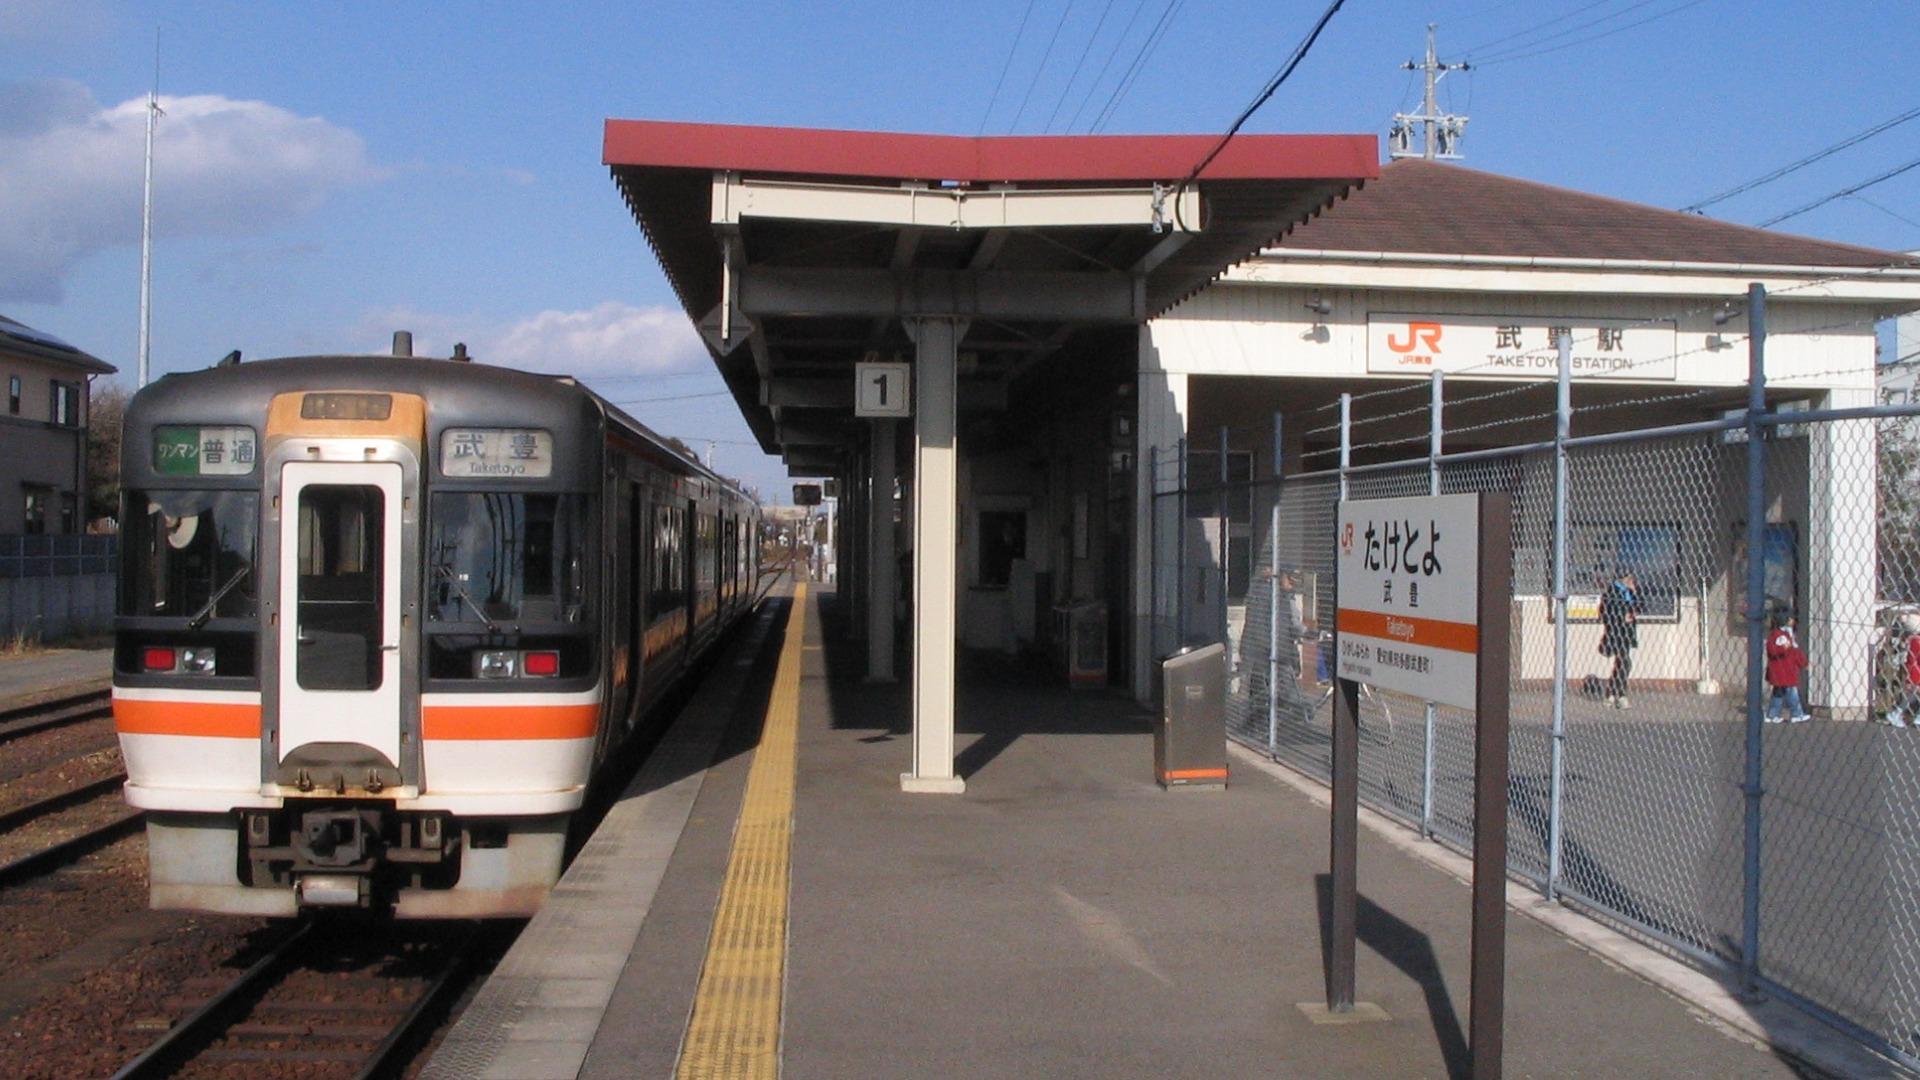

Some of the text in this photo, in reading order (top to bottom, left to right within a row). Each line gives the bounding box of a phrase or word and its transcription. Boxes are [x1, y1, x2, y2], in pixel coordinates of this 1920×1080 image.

[1388, 321, 1442, 353] JR
[1487, 354, 1633, 370] TAKETOY STATION
[873, 374, 887, 406] 1
[158, 443, 199, 458] ワンマン
[202, 439, 253, 464] 普通
[453, 433, 539, 460] 武豊
[470, 461, 526, 477] Taketoyo
[1341, 522, 1354, 548] JR
[1364, 519, 1442, 577] たけとよ
